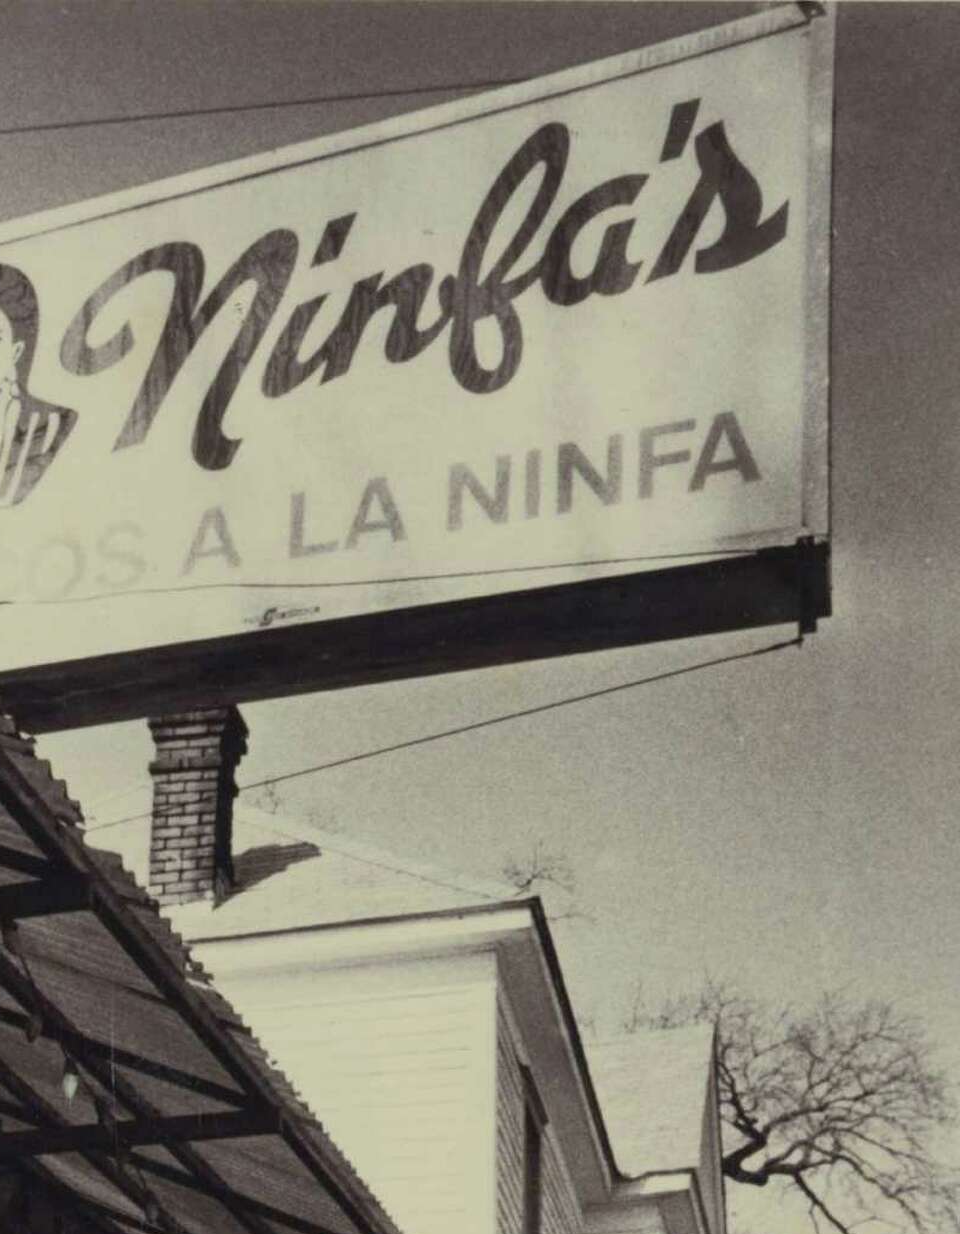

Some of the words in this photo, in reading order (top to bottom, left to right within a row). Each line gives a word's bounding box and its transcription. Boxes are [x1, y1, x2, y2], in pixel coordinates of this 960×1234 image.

[59, 98, 790, 471] Ninfa's
[180, 505, 242, 577] A
[289, 475, 430, 560] LA
[446, 410, 761, 534] NINFA
